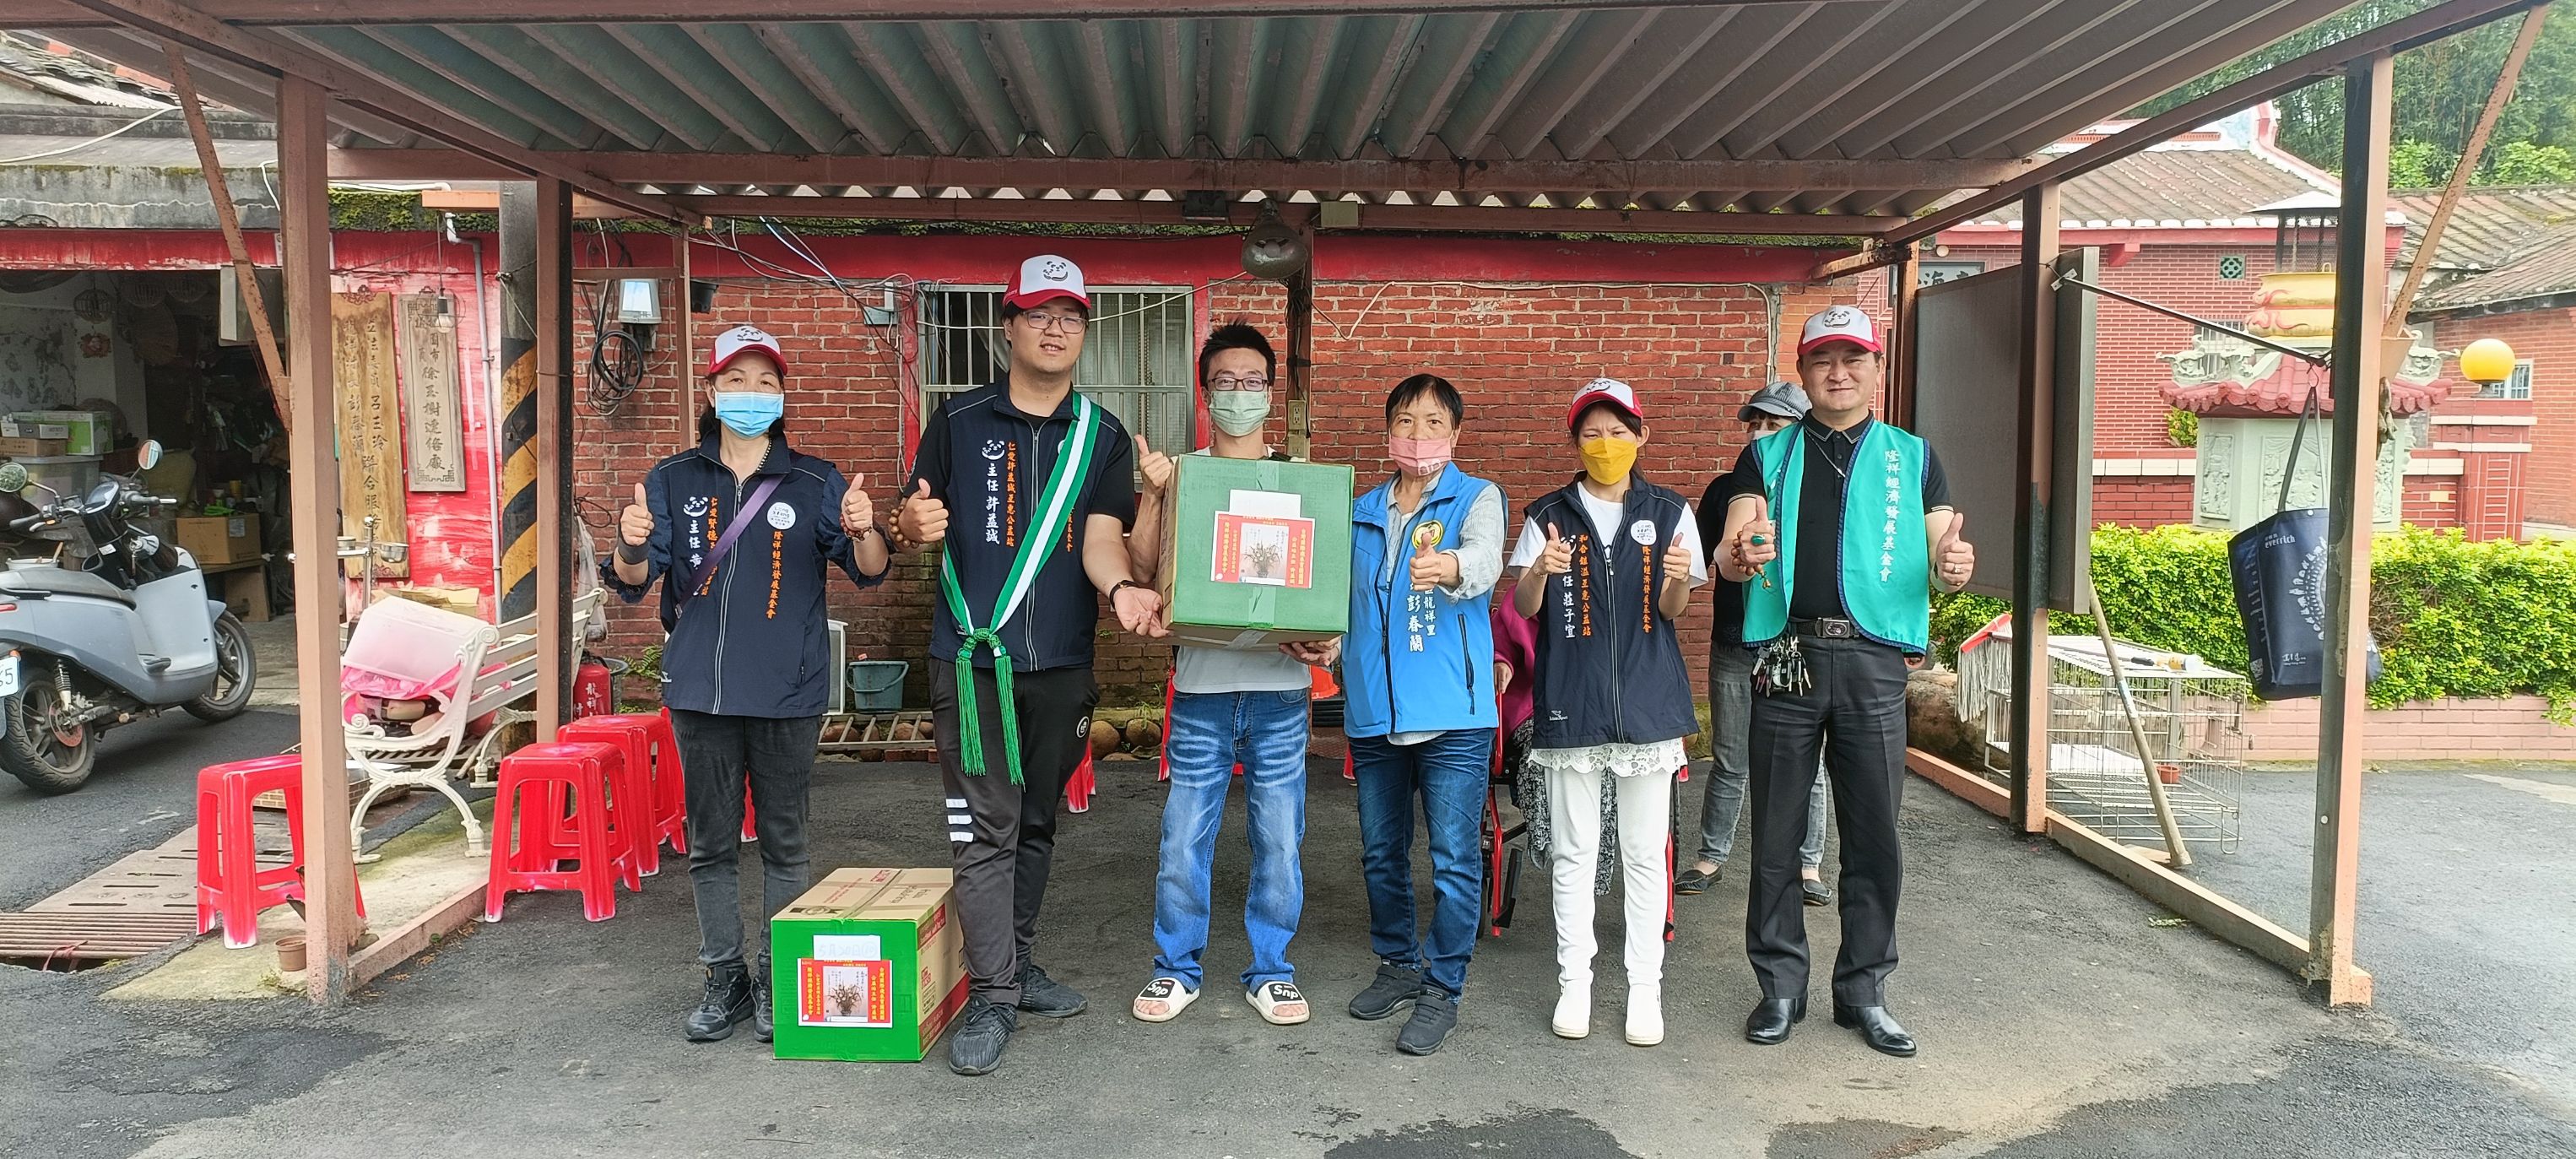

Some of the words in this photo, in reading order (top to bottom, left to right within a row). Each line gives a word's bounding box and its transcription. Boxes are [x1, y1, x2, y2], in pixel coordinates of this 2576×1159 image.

[689, 520, 701, 550] 主任
[986, 496, 1000, 545] 許益誠
[1879, 450, 1901, 582] 隆祥經濟發展基金會
[2265, 535, 2296, 549] everrich
[766, 531, 784, 620] 隆祥經濟發展基金會
[1642, 545, 1653, 634] 隆祥經濟發展基金會
[1407, 594, 1424, 653] 彭春蘭
[1562, 592, 1576, 638] 莊子宜
[1273, 984, 1299, 999] Snp
